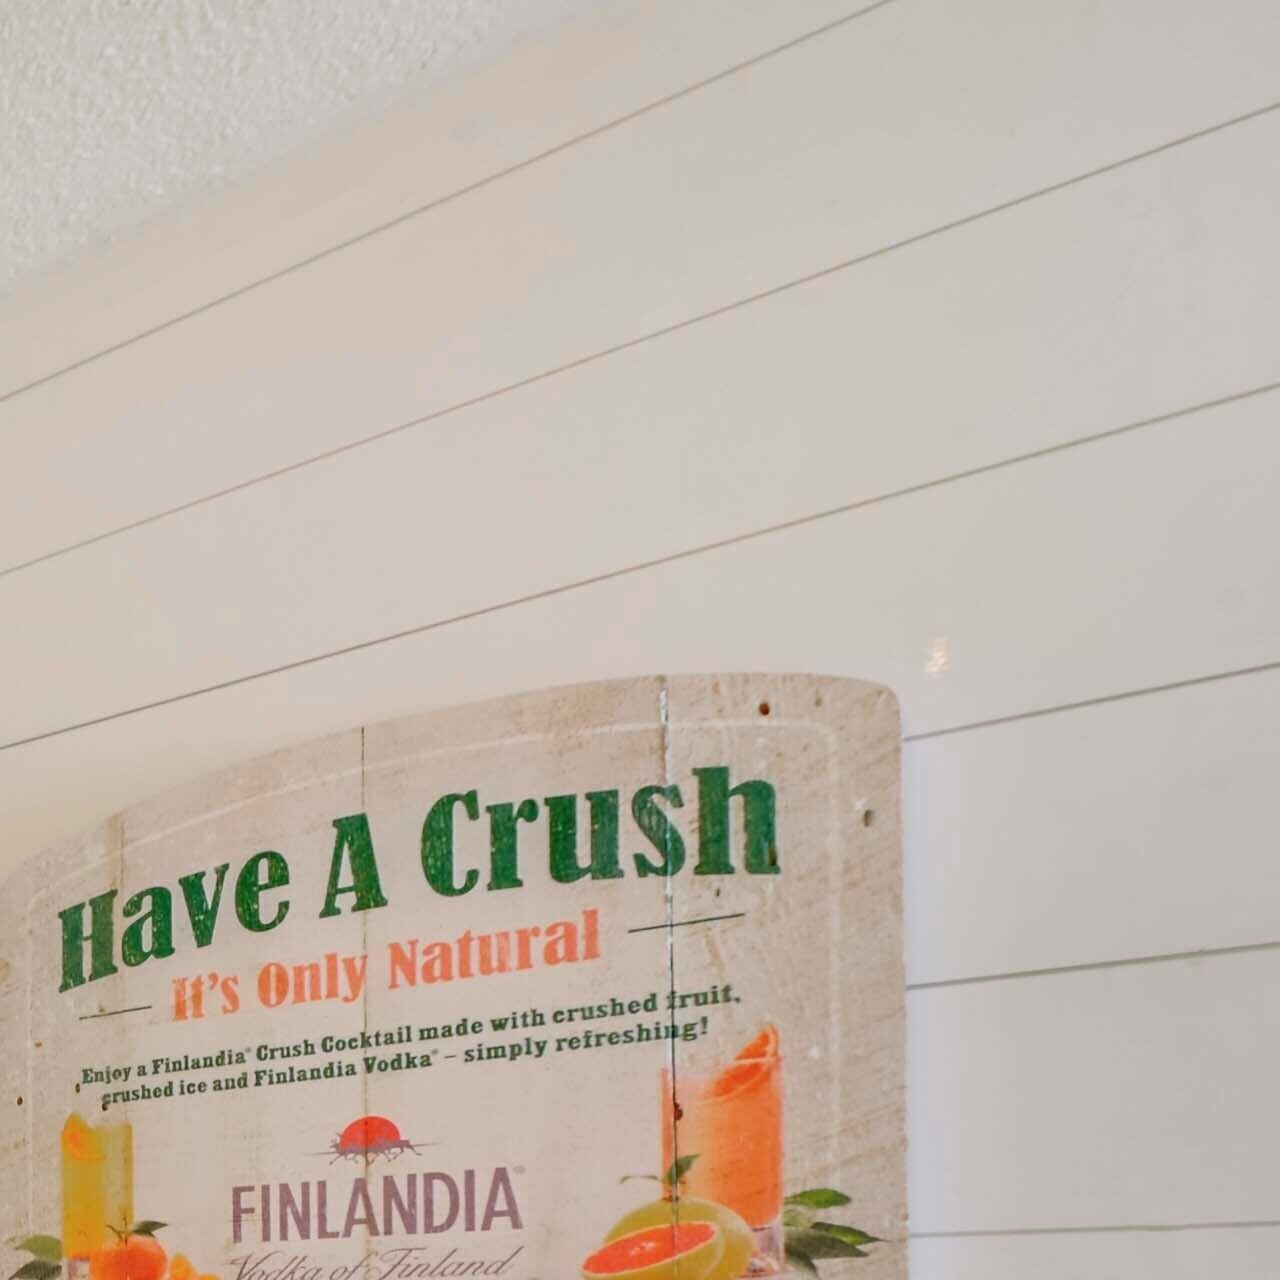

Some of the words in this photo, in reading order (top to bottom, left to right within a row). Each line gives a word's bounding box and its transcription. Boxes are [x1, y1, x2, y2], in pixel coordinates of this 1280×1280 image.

[58, 850, 290, 993] Have
[319, 812, 388, 919] A
[421, 766, 781, 896] Crush
[171, 972, 239, 1021] It's
[257, 953, 368, 1009] Only
[387, 908, 600, 989] Natural
[82, 1066, 131, 1085] Enjoy
[137, 1063, 147, 1076] a
[256, 1040, 316, 1061] Crush
[321, 1026, 412, 1053] Cocktail
[419, 1018, 483, 1041] made
[490, 1008, 545, 1031] with
[552, 993, 657, 1023] crushed
[102, 1083, 174, 1105] crushed
[180, 1078, 207, 1096] ice
[213, 1072, 248, 1092] and
[254, 1060, 357, 1087] Finlandia
[464, 1038, 548, 1063] simply
[555, 1016, 709, 1051] refreshing!
[232, 1167, 523, 1243] FINLANDIA
